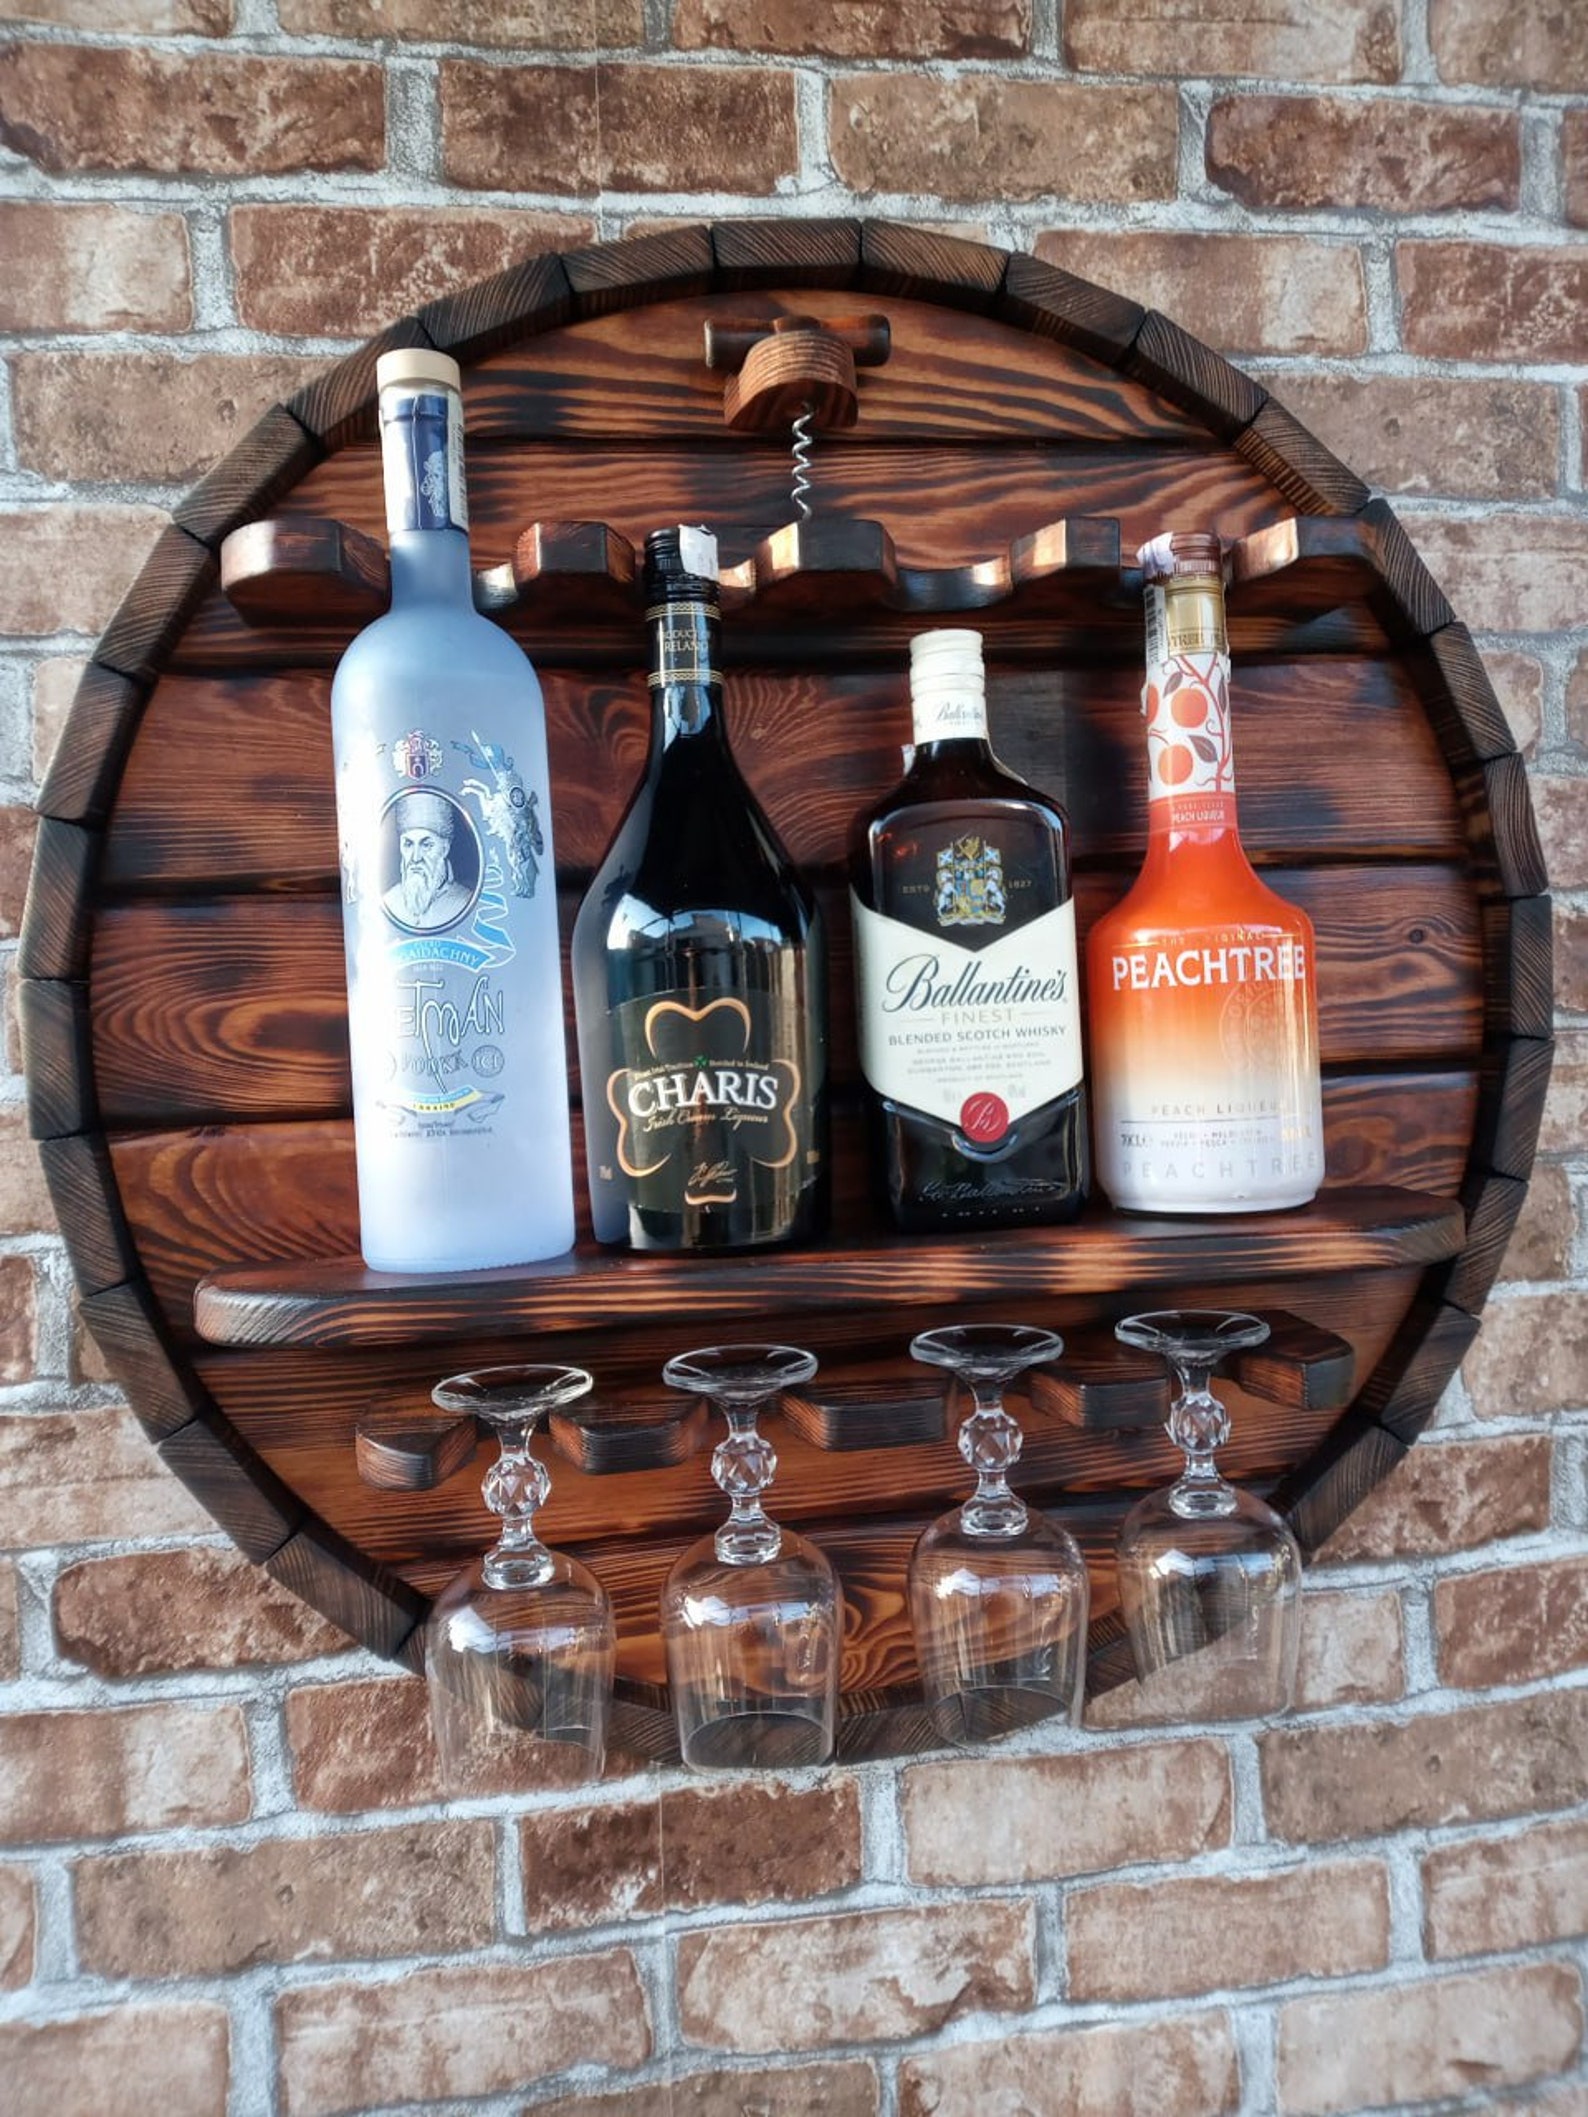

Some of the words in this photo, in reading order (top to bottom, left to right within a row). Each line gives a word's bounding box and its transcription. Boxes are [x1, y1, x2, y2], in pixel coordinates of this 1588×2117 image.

[1112, 945, 1305, 991] PEACHTREE
[882, 954, 1067, 1013] Ballantine's
[941, 1008, 1014, 1026] FINEST
[888, 1031, 952, 1046] BLENDED
[957, 1028, 1011, 1042] SCOTCH
[1015, 1025, 1067, 1038] WHISKY
[628, 1071, 778, 1117] CHARIS
[643, 1107, 676, 1132] Irish
[1122, 1152, 1316, 1179] PEACHTREE
